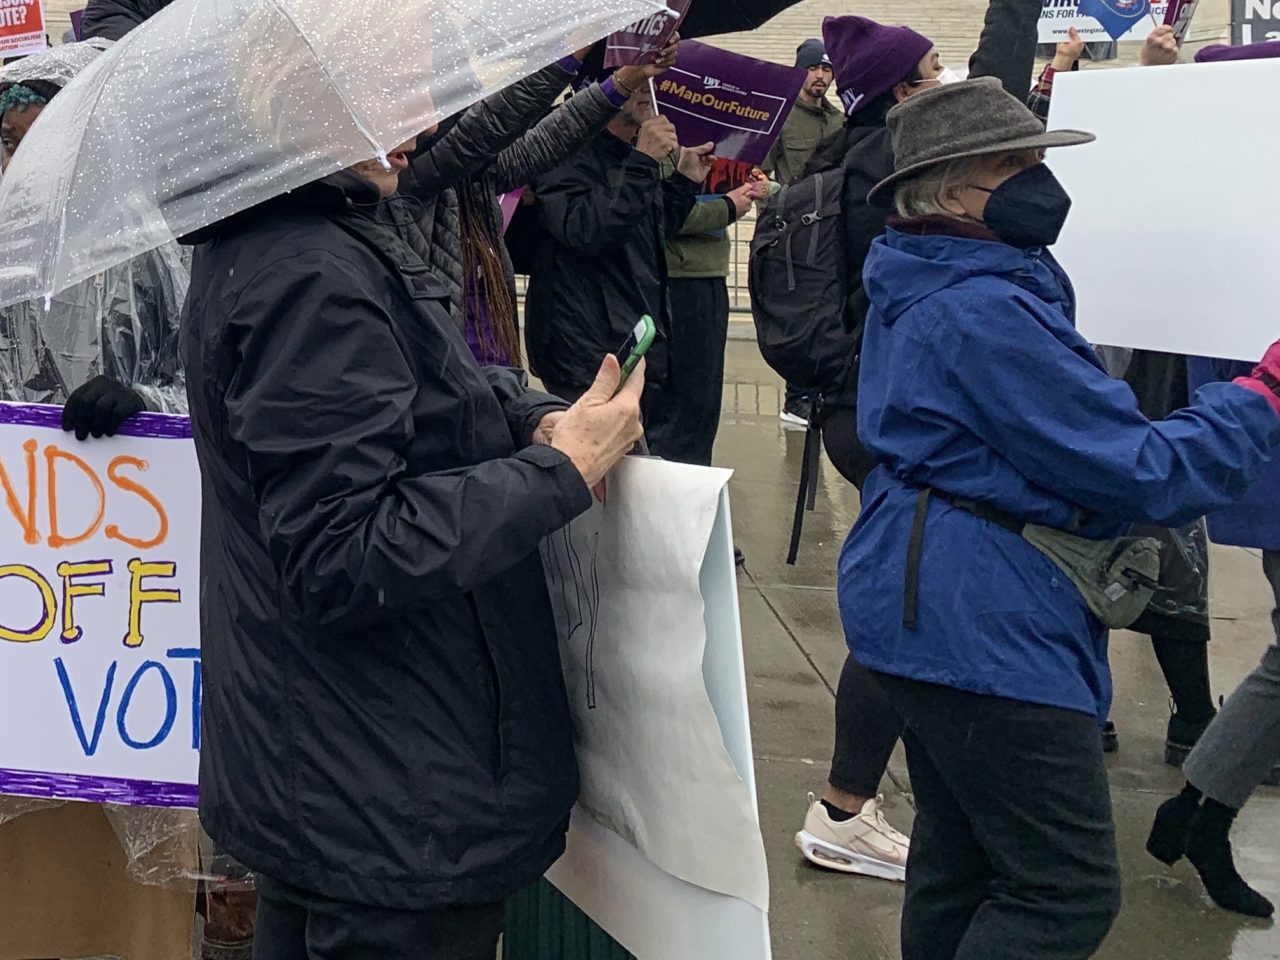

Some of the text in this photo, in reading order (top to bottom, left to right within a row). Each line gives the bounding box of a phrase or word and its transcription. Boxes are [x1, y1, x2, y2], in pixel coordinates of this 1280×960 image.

[1056, 8, 1074, 18] FOR
[660, 79, 770, 121] #MapOurFuture
[54, 647, 202, 757] VOT
